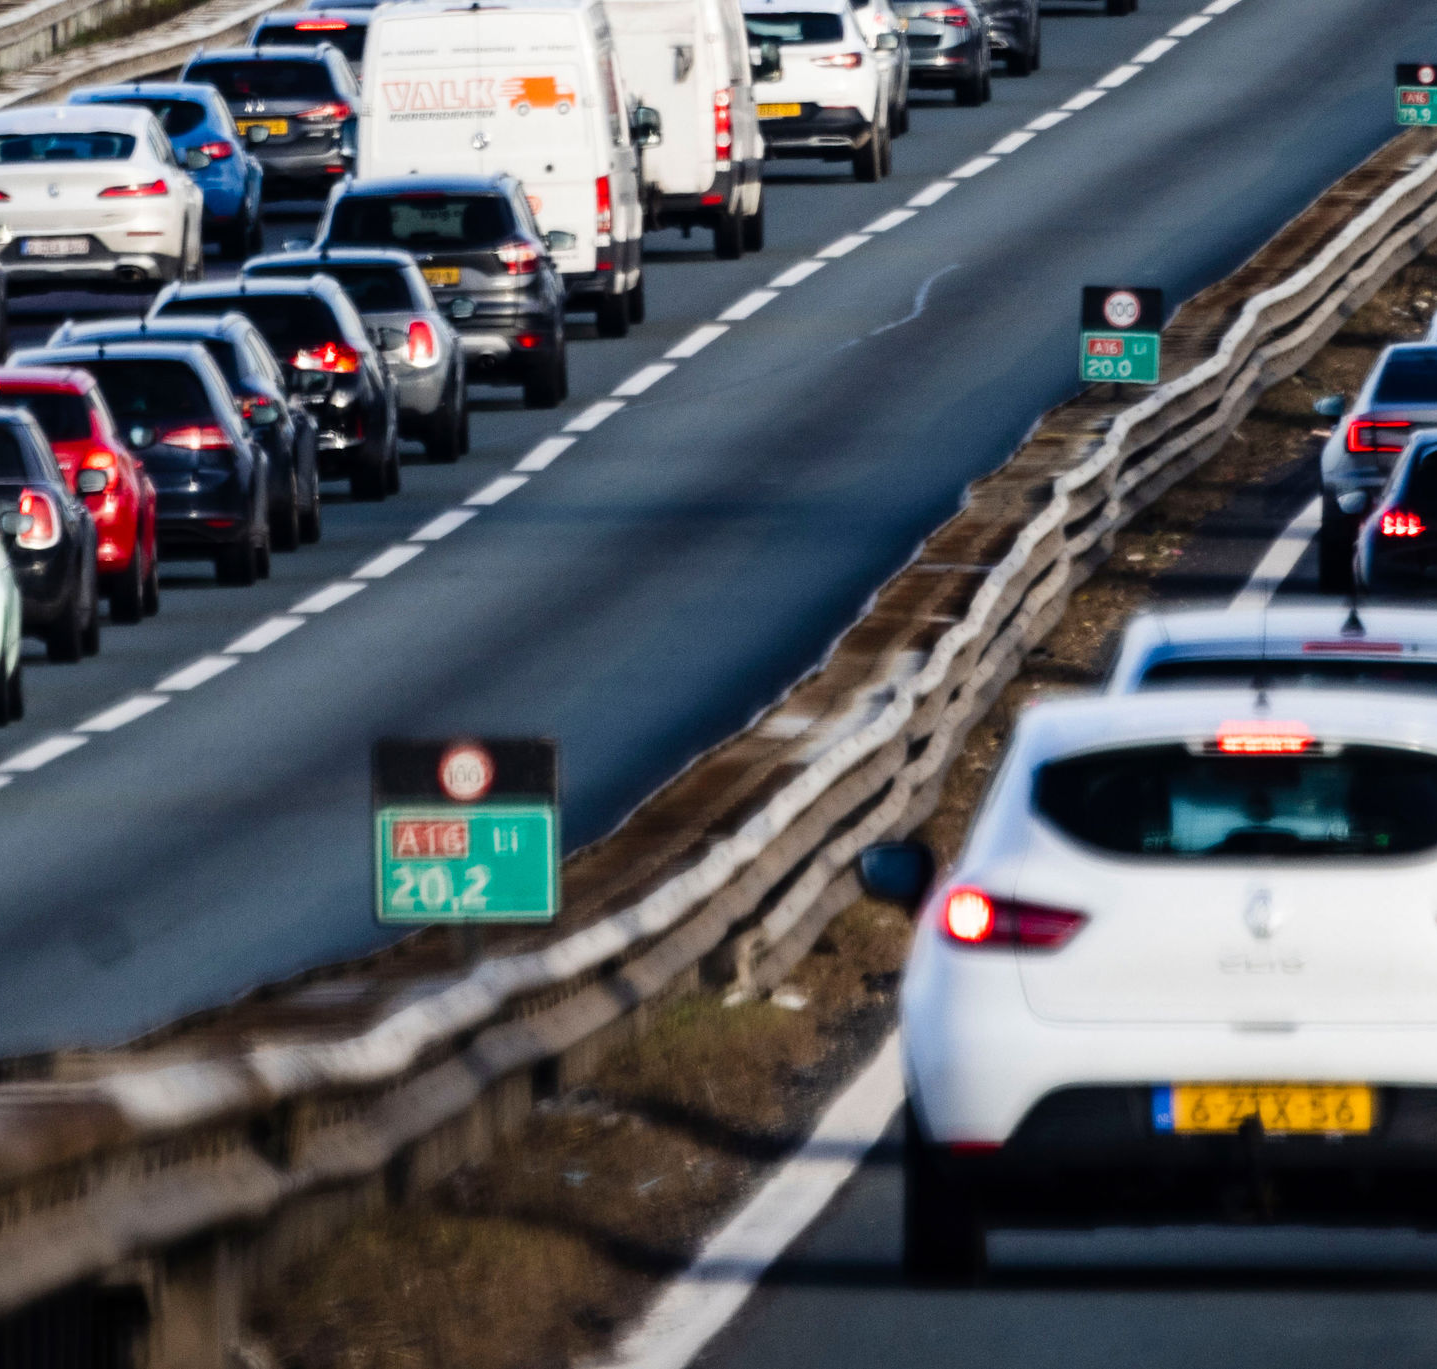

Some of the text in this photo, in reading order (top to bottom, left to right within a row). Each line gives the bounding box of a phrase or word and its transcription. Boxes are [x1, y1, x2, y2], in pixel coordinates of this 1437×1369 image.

[381, 78, 497, 112] VALK
[1093, 342, 1119, 354] A16
[397, 823, 463, 854] A16
